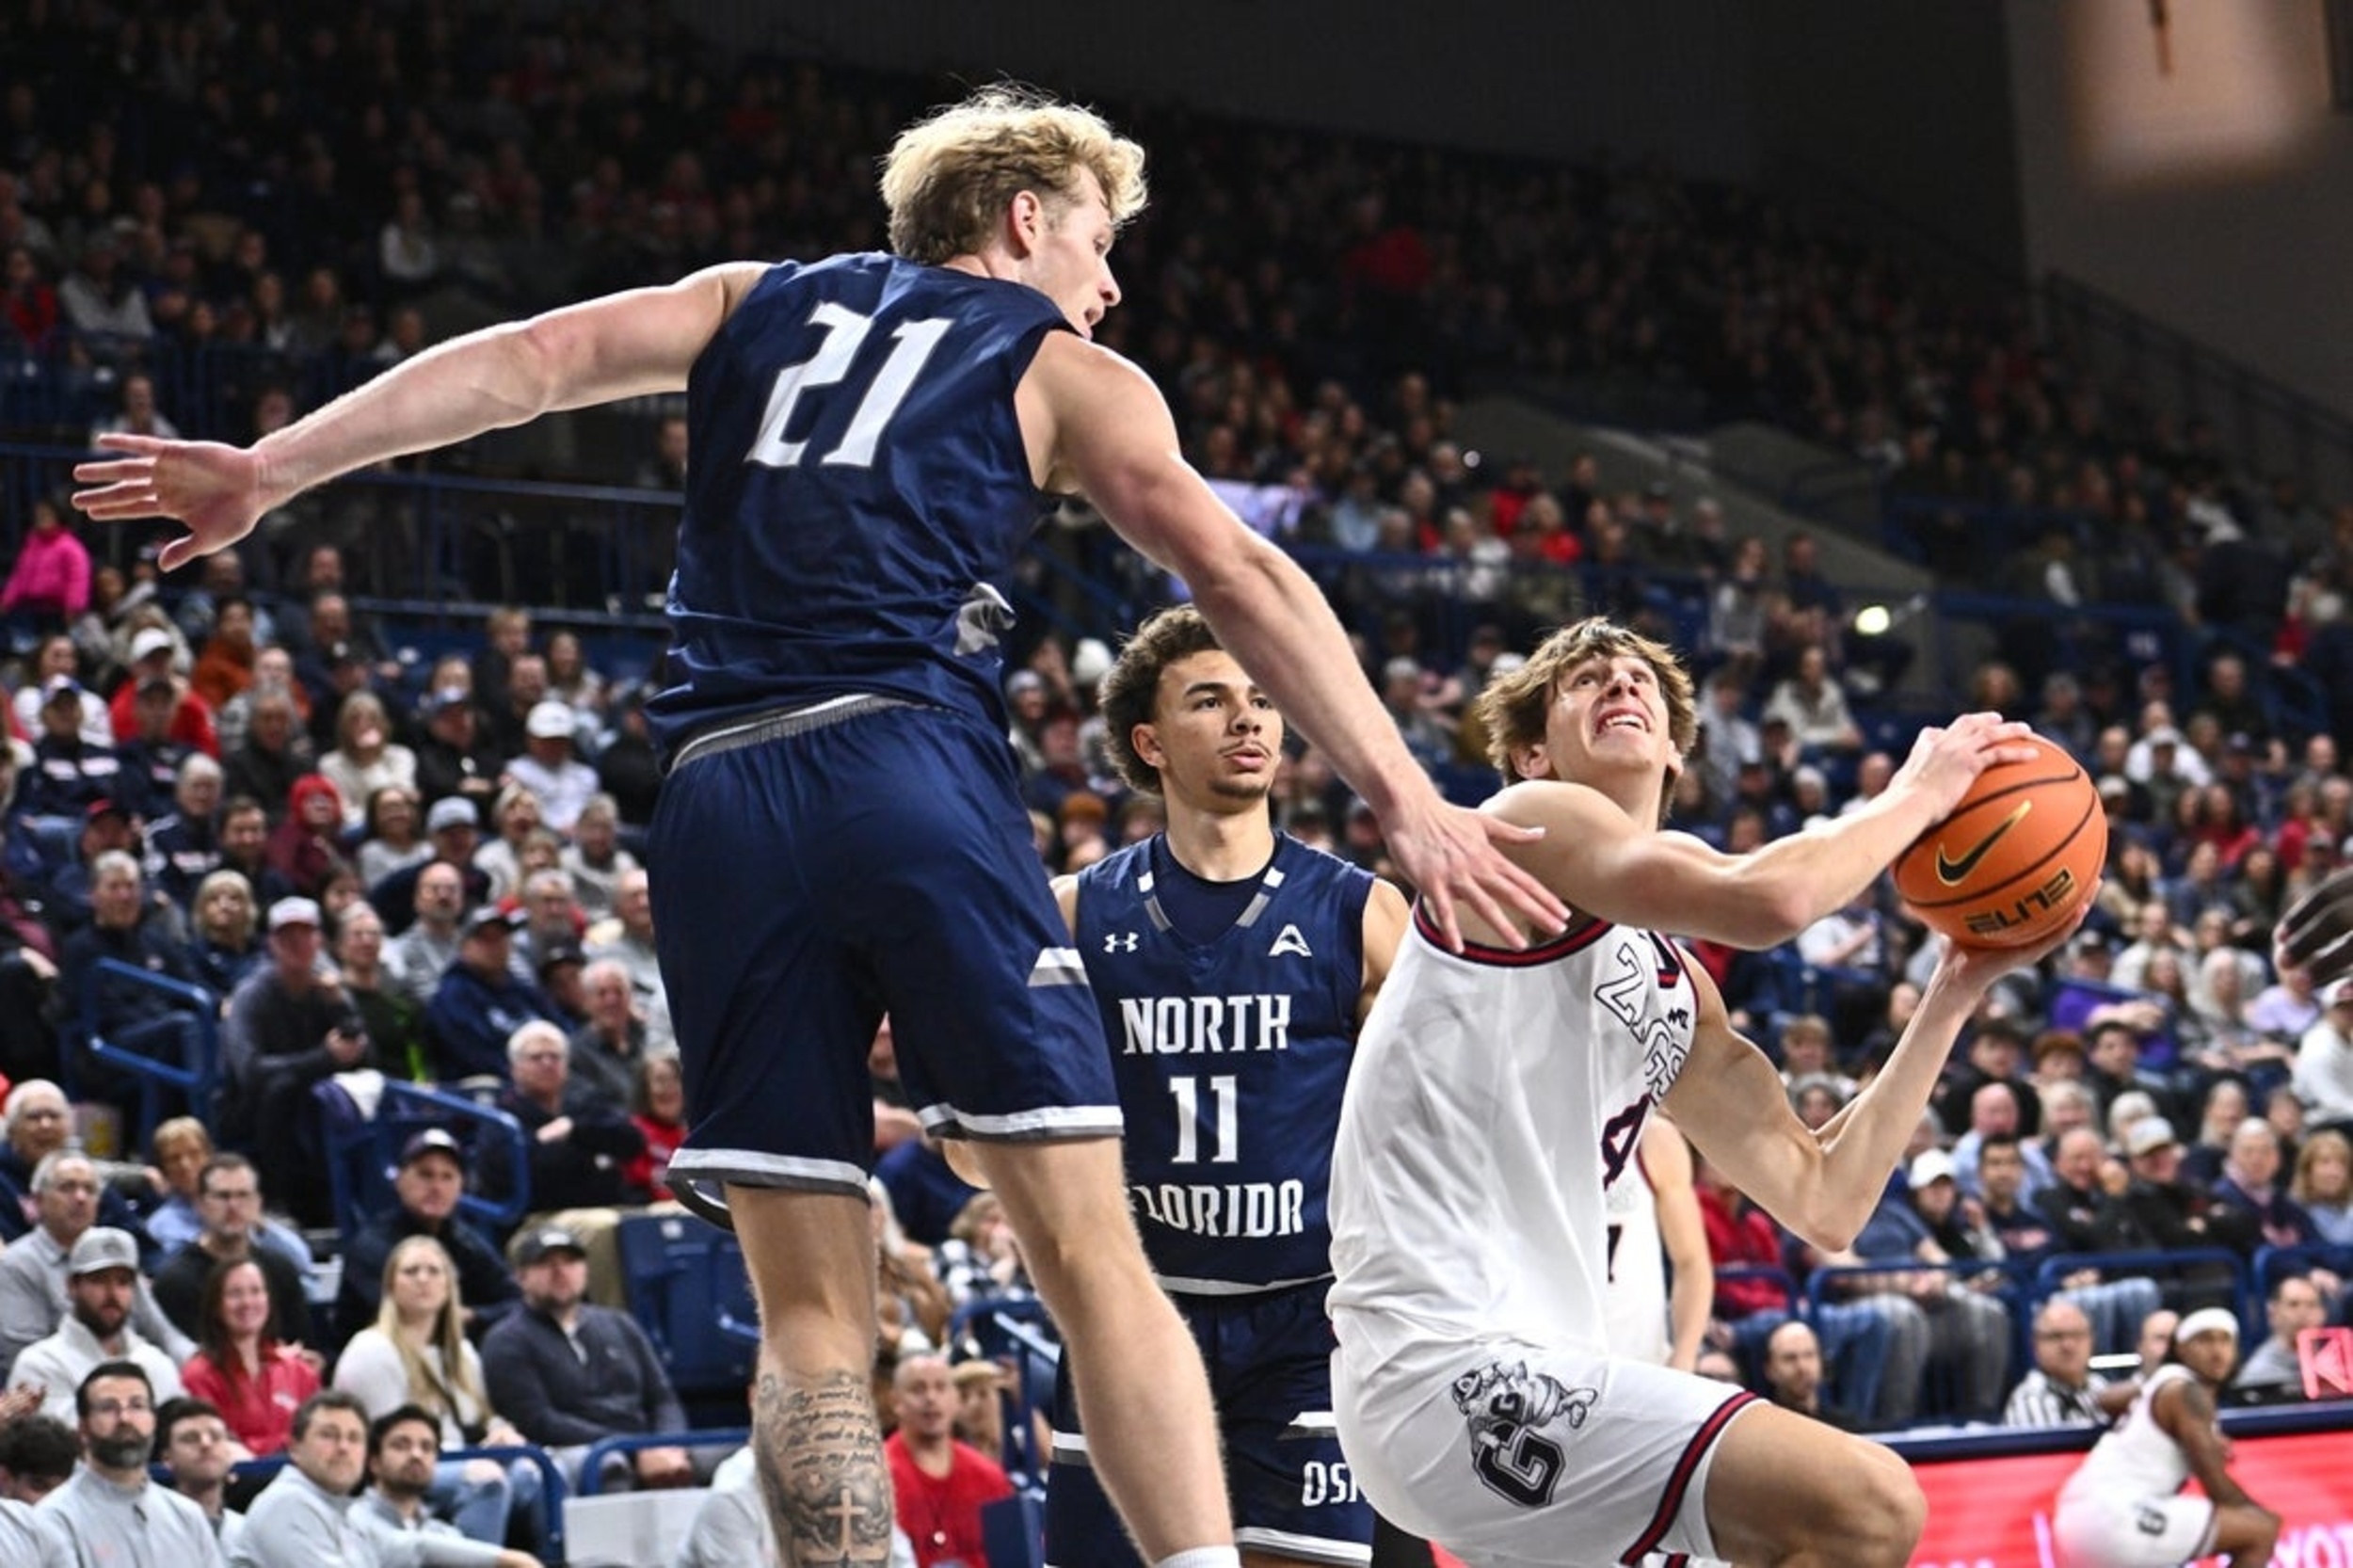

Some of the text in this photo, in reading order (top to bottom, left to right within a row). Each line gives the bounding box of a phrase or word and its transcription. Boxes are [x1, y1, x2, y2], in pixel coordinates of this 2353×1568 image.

[744, 302, 954, 467] 21
[1963, 868, 2075, 935] ELITE
[1119, 994, 1291, 1055] NORTH
[1169, 1075, 1239, 1163] 11
[1130, 1178, 1305, 1239] LORIDA
